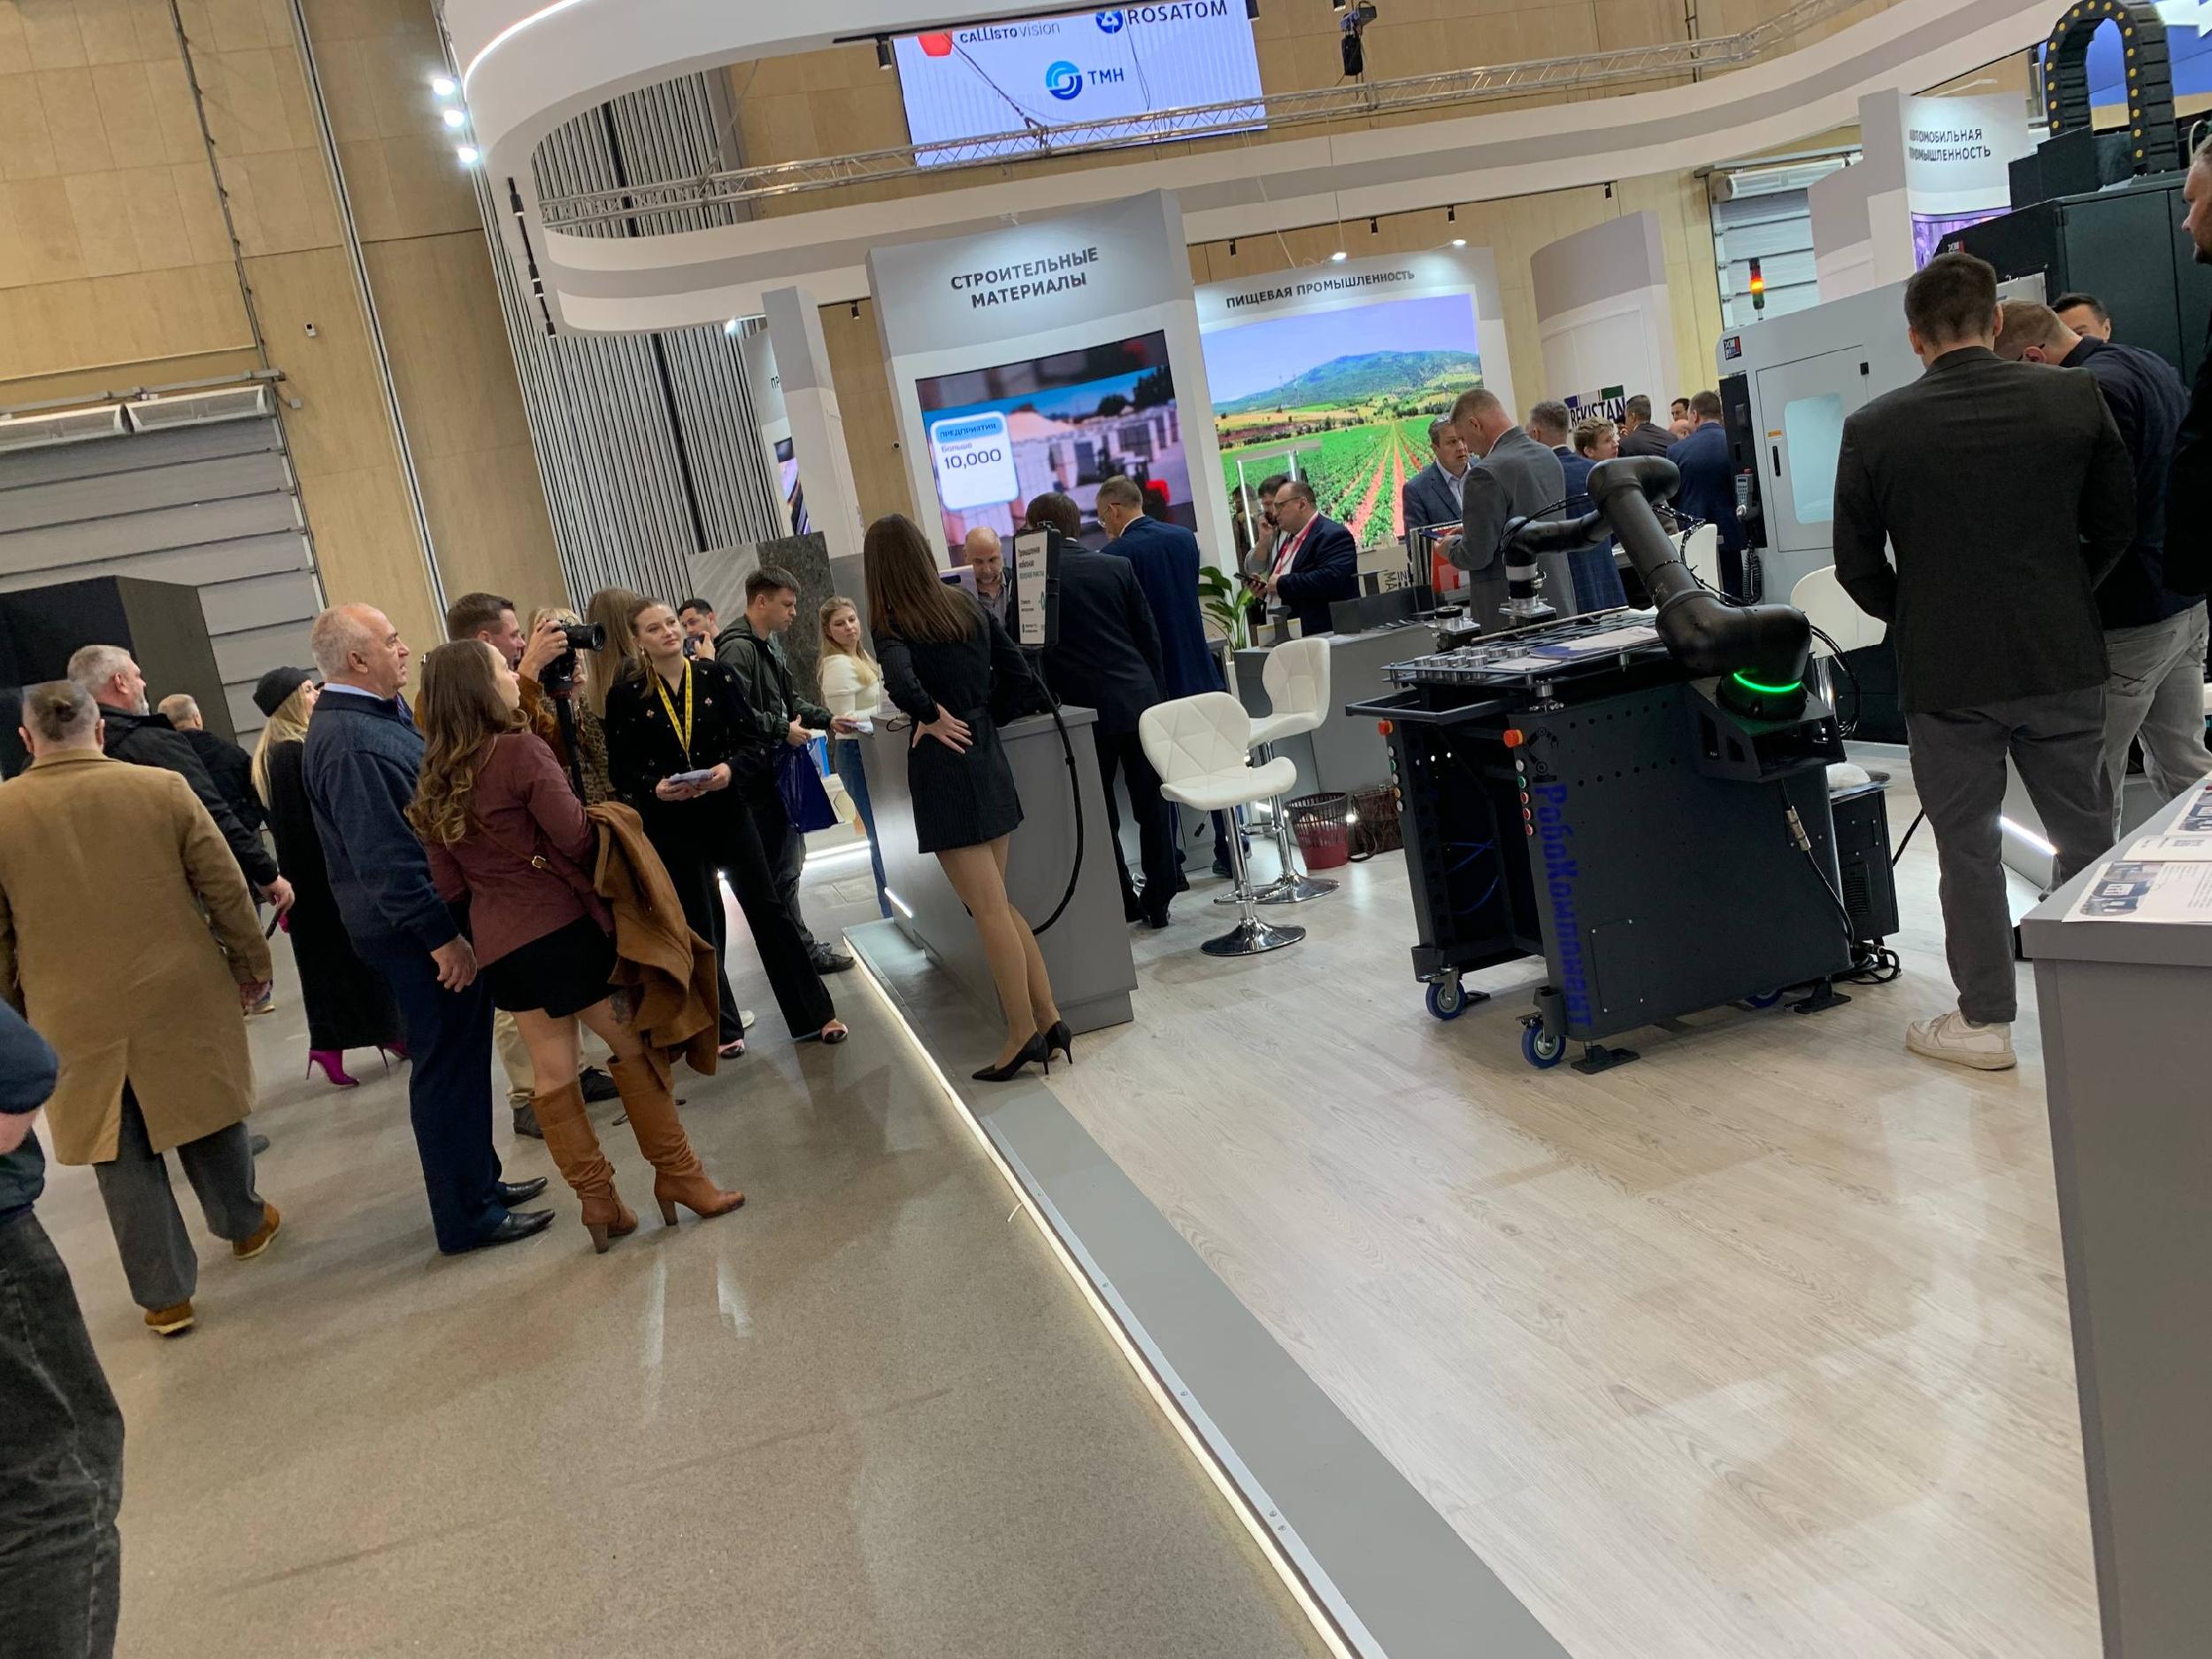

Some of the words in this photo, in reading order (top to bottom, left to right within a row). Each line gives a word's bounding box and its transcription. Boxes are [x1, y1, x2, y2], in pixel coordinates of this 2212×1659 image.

[1128, 1, 1227, 25] ROSATOM
[960, 27, 1018, 43] CALLISTO
[1087, 67, 1125, 85] TMH
[950, 247, 1099, 289] СТРОИТЕЛЬНЫЕ
[972, 272, 1087, 308] МАТЕРИАЛЫ
[1226, 287, 1294, 309] ПИЩЕВАЯ
[1297, 270, 1416, 296] ПРОМЫШЛЕННОСТЬ
[944, 449, 1002, 469] 10,000
[1534, 784, 1592, 1026] РобоКомпонент
